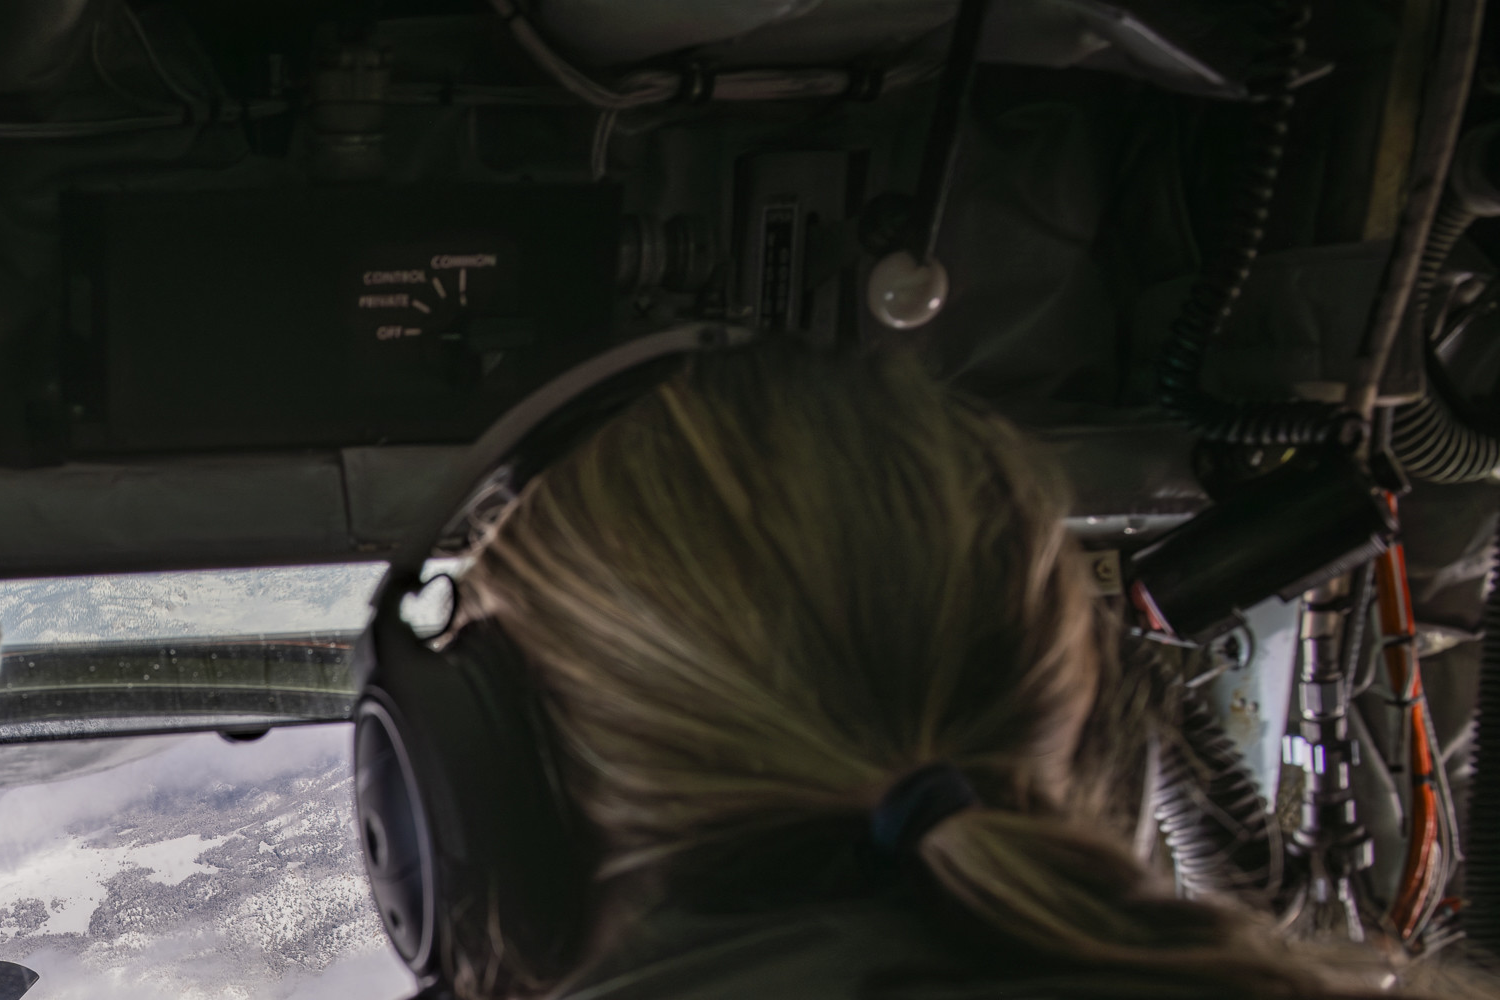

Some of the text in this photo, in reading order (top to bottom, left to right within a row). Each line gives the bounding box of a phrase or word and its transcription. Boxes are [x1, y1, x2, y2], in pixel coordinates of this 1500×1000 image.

[430, 255, 497, 270] COMMON
[363, 270, 426, 286] CONTROL
[358, 294, 410, 308] PRIVATE
[376, 325, 403, 340] OFF
